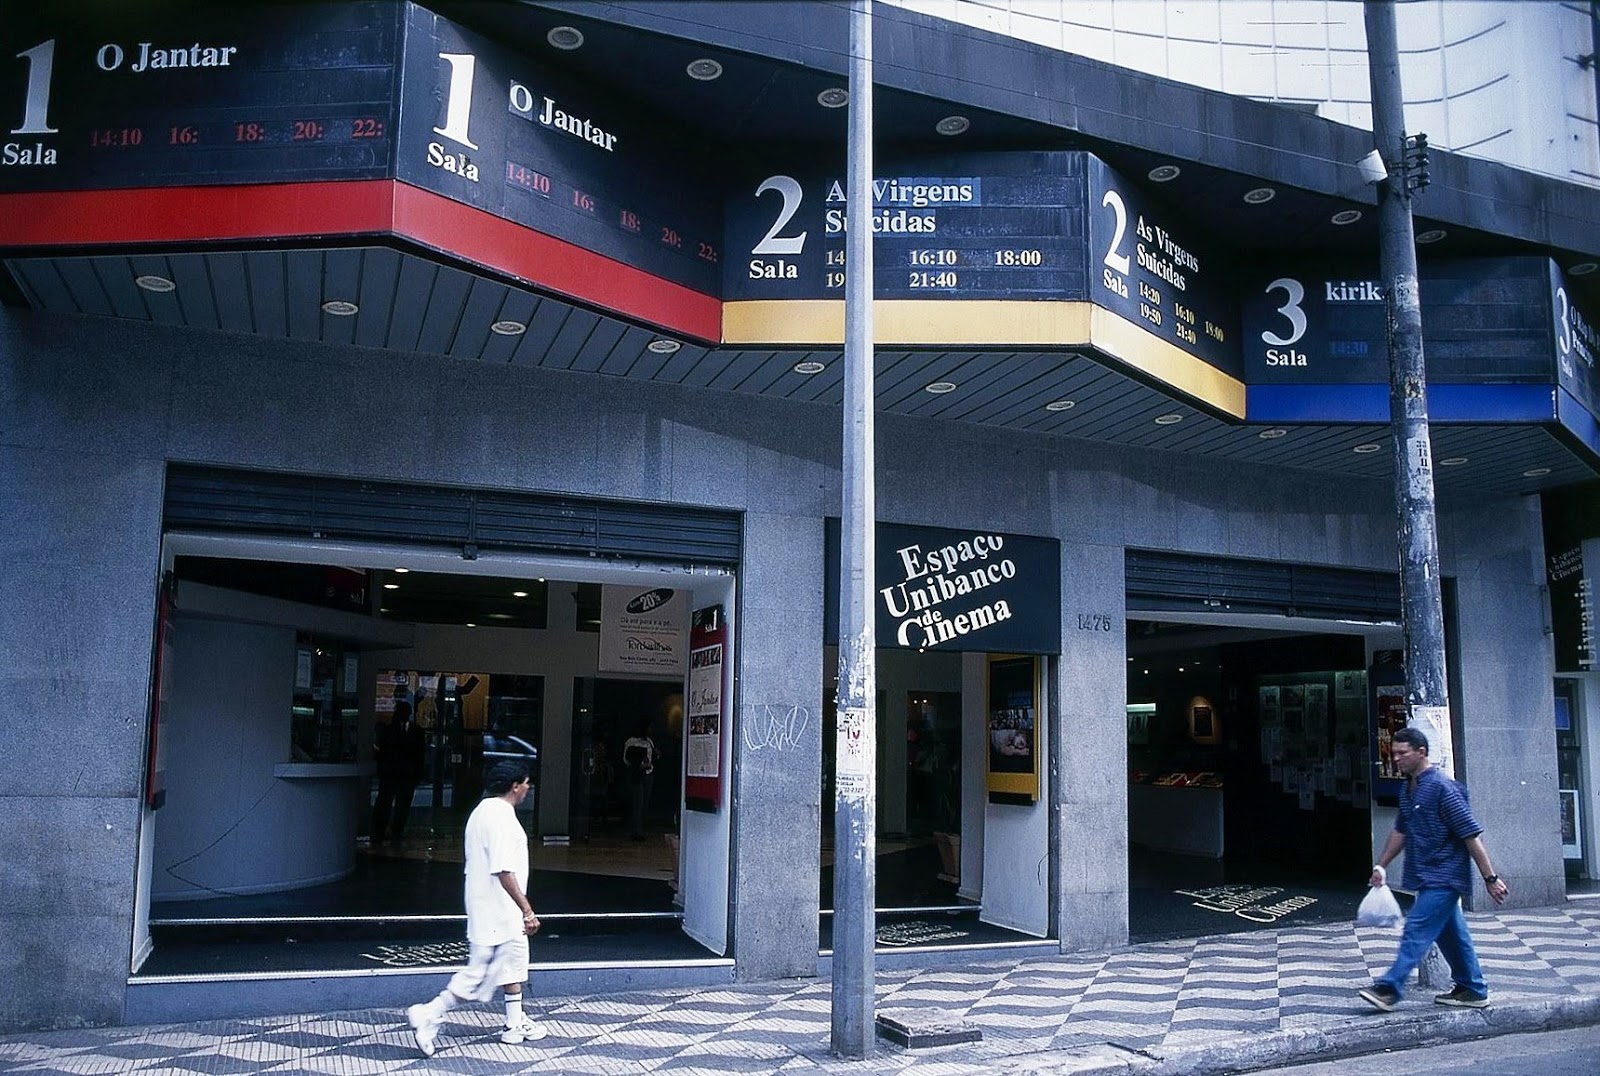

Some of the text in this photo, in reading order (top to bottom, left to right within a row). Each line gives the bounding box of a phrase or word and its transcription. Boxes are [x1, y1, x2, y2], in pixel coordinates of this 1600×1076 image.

[96, 42, 237, 72] O Jantar
[11, 39, 59, 135] 1
[433, 52, 479, 151] 1
[89, 119, 384, 147] 14:10 16: 18: 20: 22:
[509, 84, 618, 152] O Jantar
[2, 142, 58, 166] Sala
[427, 142, 480, 182] Sala
[506, 163, 550, 195] 14:10
[826, 180, 973, 207] A Virgens
[751, 175, 807, 255] 2
[826, 210, 936, 233] Scidas
[1102, 190, 1131, 276] 2
[911, 250, 1042, 266] 16:10 18:00
[1136, 215, 1199, 273] As Virgens
[749, 260, 799, 279] Sala
[909, 272, 958, 288] 21:40
[1103, 269, 1129, 299] Sala
[1137, 243, 1186, 291] Suicidas
[1139, 281, 1161, 305] 14:20
[1175, 302, 1195, 325] 16:10
[1325, 282, 1385, 300] kirik
[1140, 303, 1197, 345] 19:50 21:40
[1261, 277, 1308, 346] 3
[1556, 286, 1571, 355] 3
[1265, 349, 1308, 366] Sala
[896, 535, 1004, 582] Espaço
[880, 559, 1017, 618] Unibanco
[897, 600, 1012, 653] Cinema
[921, 609, 943, 627] de
[1077, 613, 1111, 631] 1475
